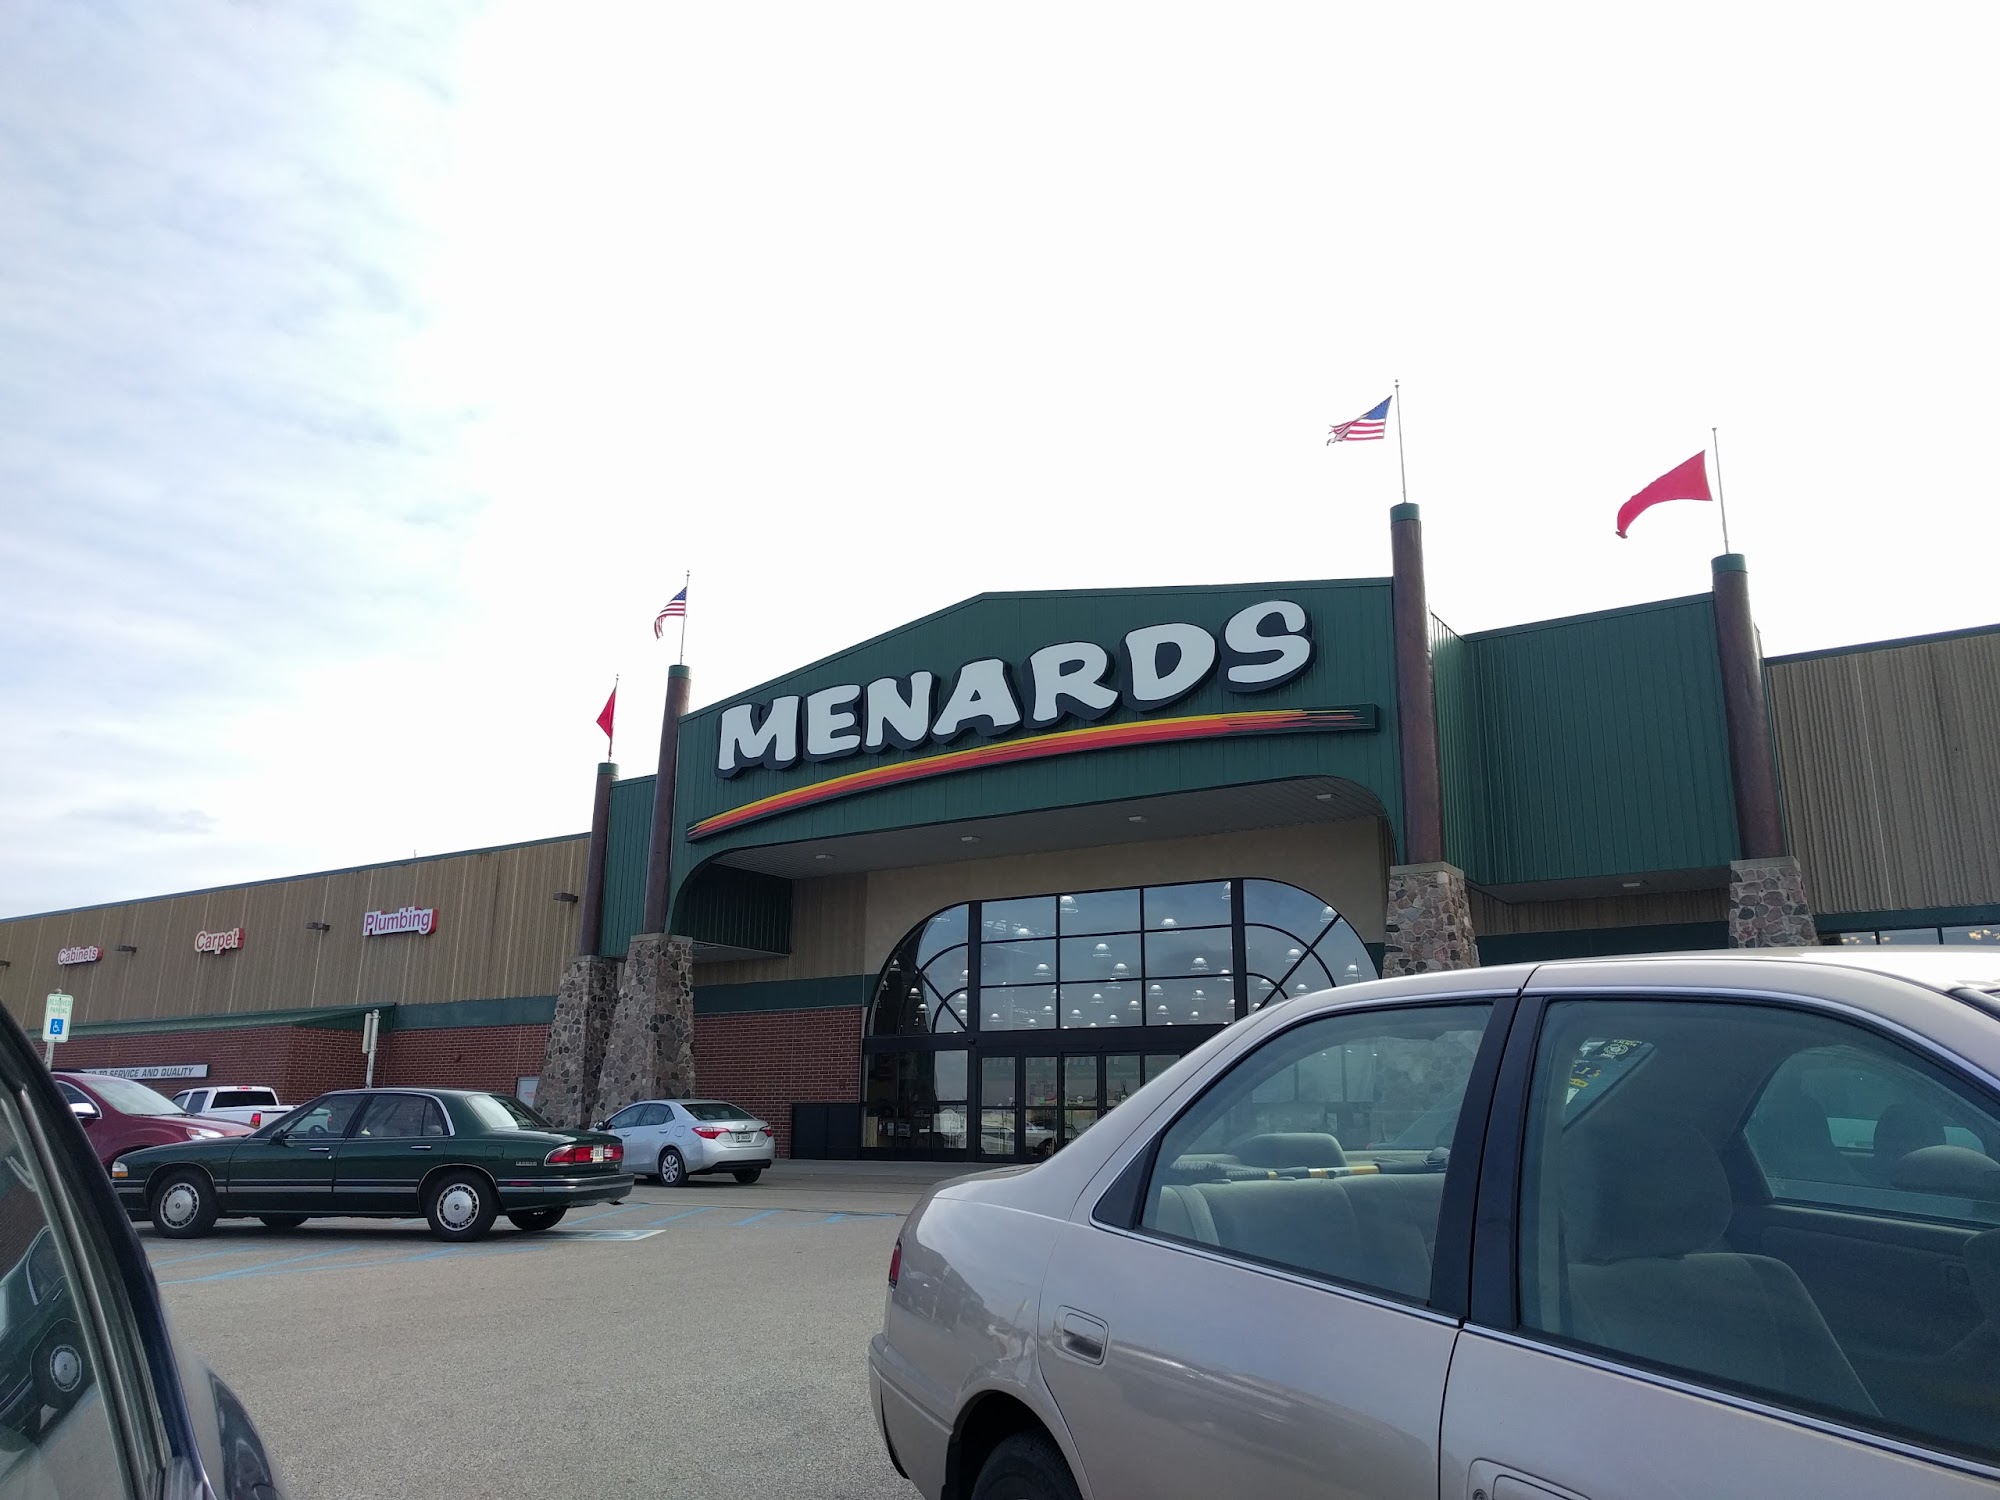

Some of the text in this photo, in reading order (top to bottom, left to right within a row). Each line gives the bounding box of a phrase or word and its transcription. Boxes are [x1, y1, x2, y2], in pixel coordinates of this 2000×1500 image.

[716, 599, 1311, 770] MENARDS
[364, 908, 432, 933] Plumbing
[196, 929, 239, 953] Carpet
[58, 946, 98, 964] Cabinets
[110, 1069, 139, 1078] SERVICE
[141, 1068, 159, 1078] AND
[160, 1067, 194, 1077] QUALITY
